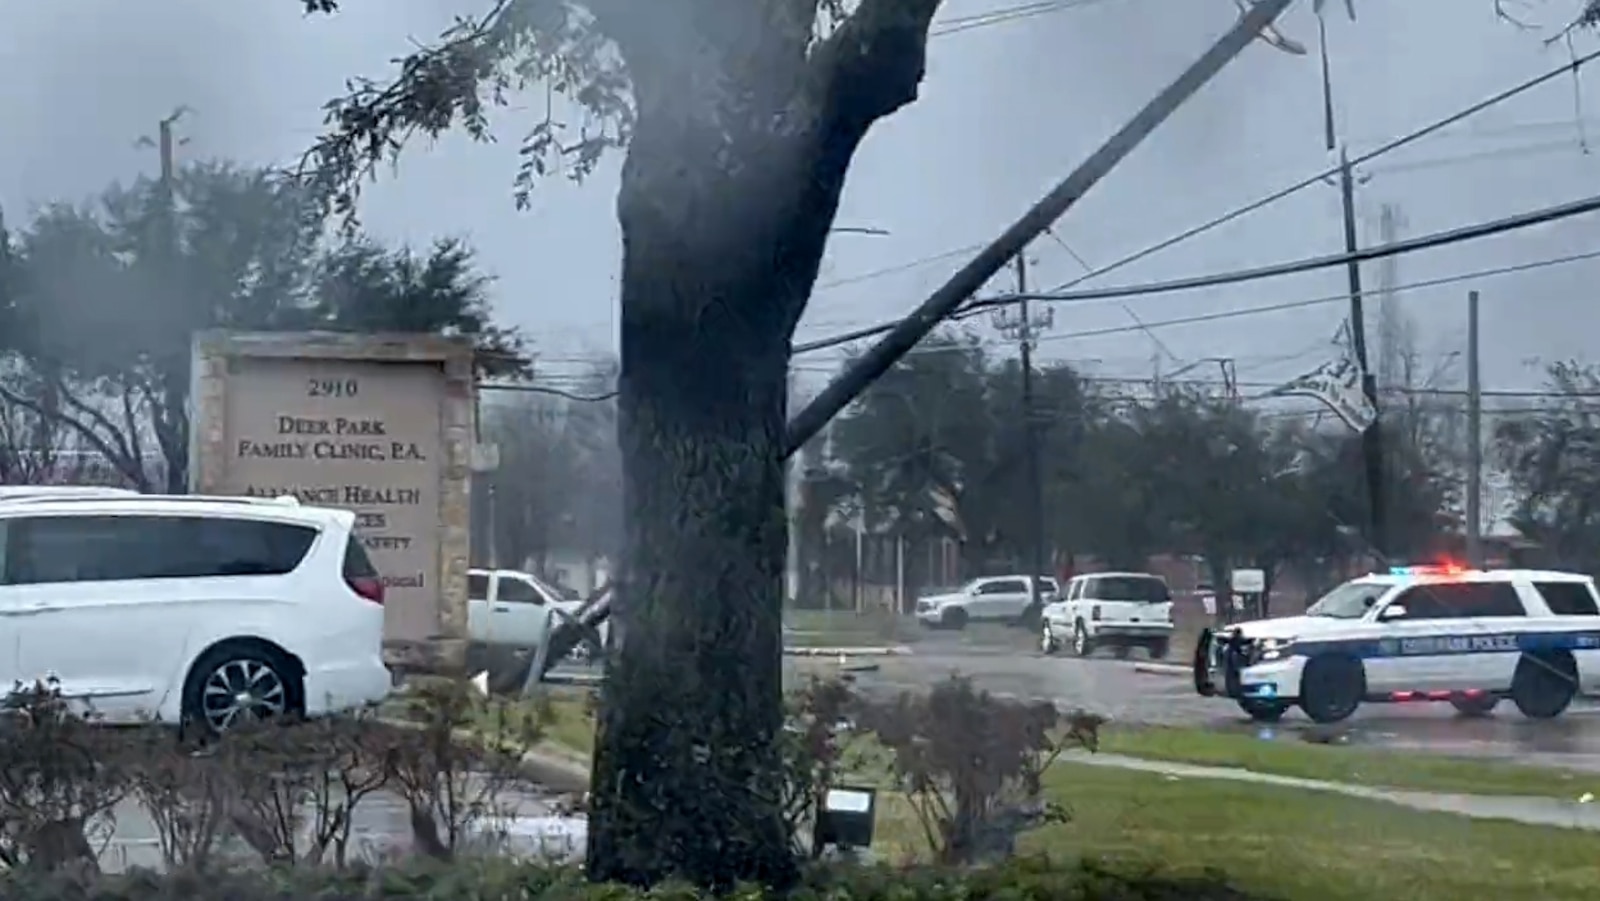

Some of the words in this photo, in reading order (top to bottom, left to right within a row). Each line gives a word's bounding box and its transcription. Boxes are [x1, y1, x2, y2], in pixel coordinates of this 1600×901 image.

[308, 379, 358, 398] 2910
[278, 416, 331, 435] DEER
[336, 417, 387, 436] PARK
[238, 439, 308, 460] FAMILY
[343, 485, 421, 505] HEALTH
